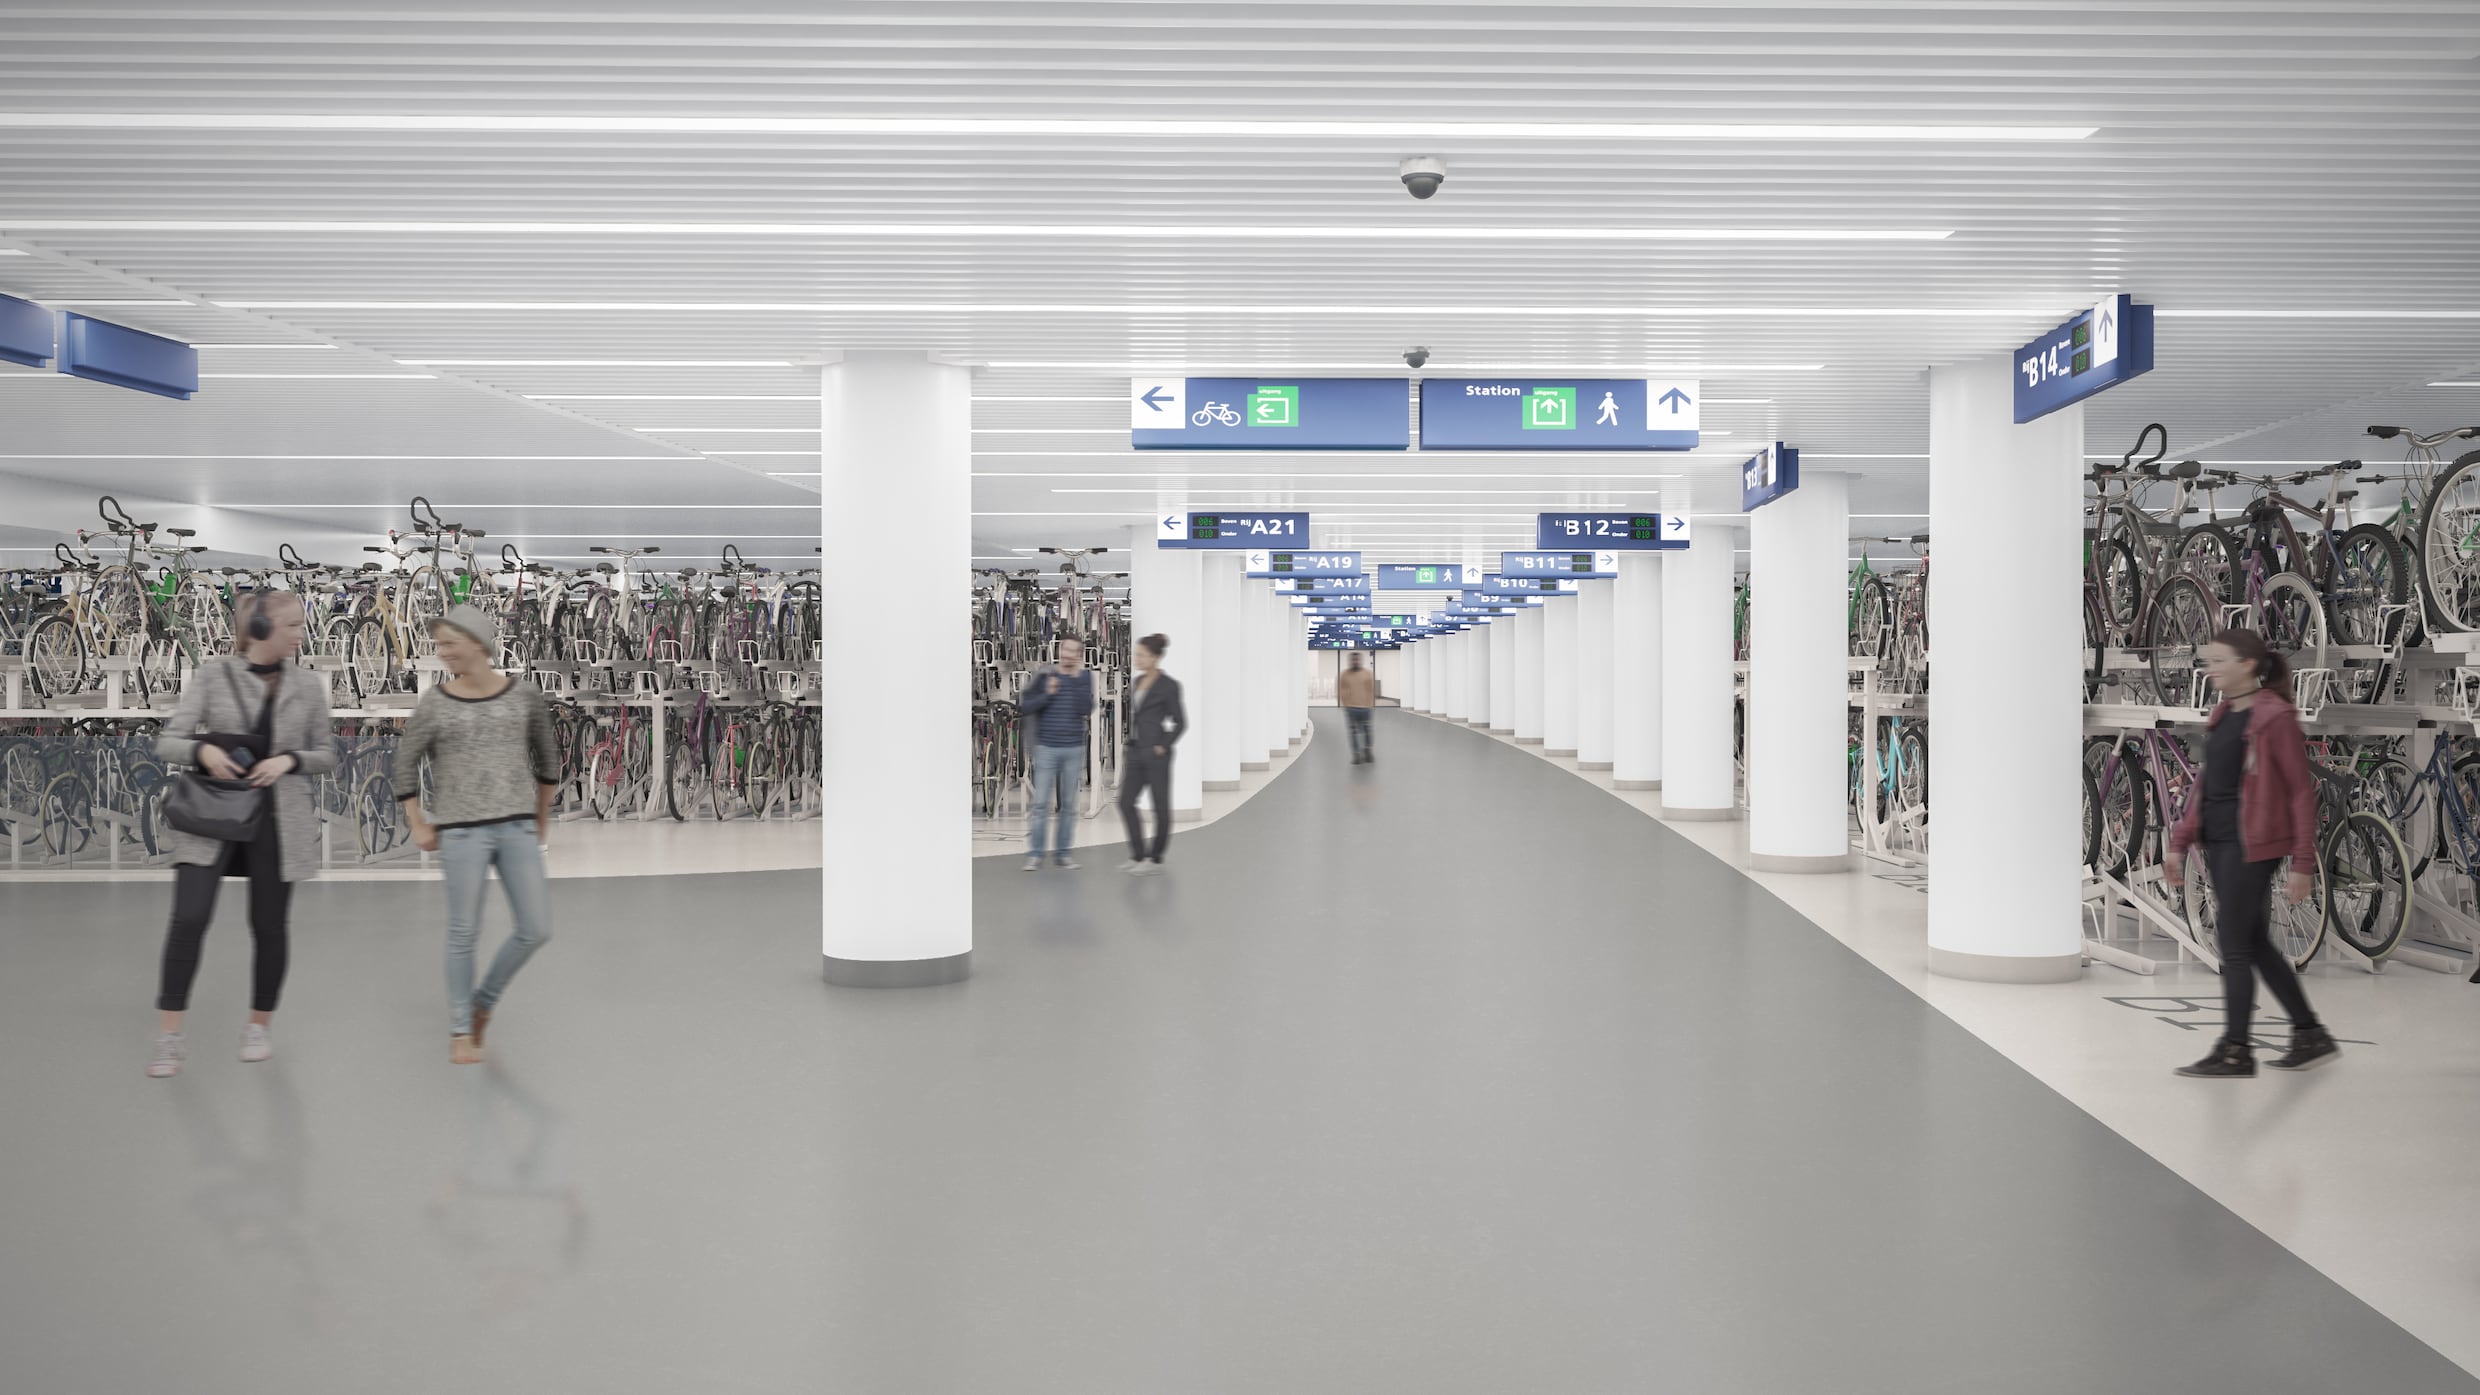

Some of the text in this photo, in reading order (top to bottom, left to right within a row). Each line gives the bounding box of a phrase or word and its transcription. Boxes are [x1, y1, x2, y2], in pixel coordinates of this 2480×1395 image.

[2029, 345, 2058, 388] B14
[1466, 385, 1520, 397] Station
[1240, 519, 1295, 535] Rij A21
[1566, 519, 1609, 536] B12
[1316, 556, 1352, 569] A19
[1523, 556, 1555, 569] B11
[1333, 578, 1363, 588] A17
[1500, 578, 1528, 588] B10
